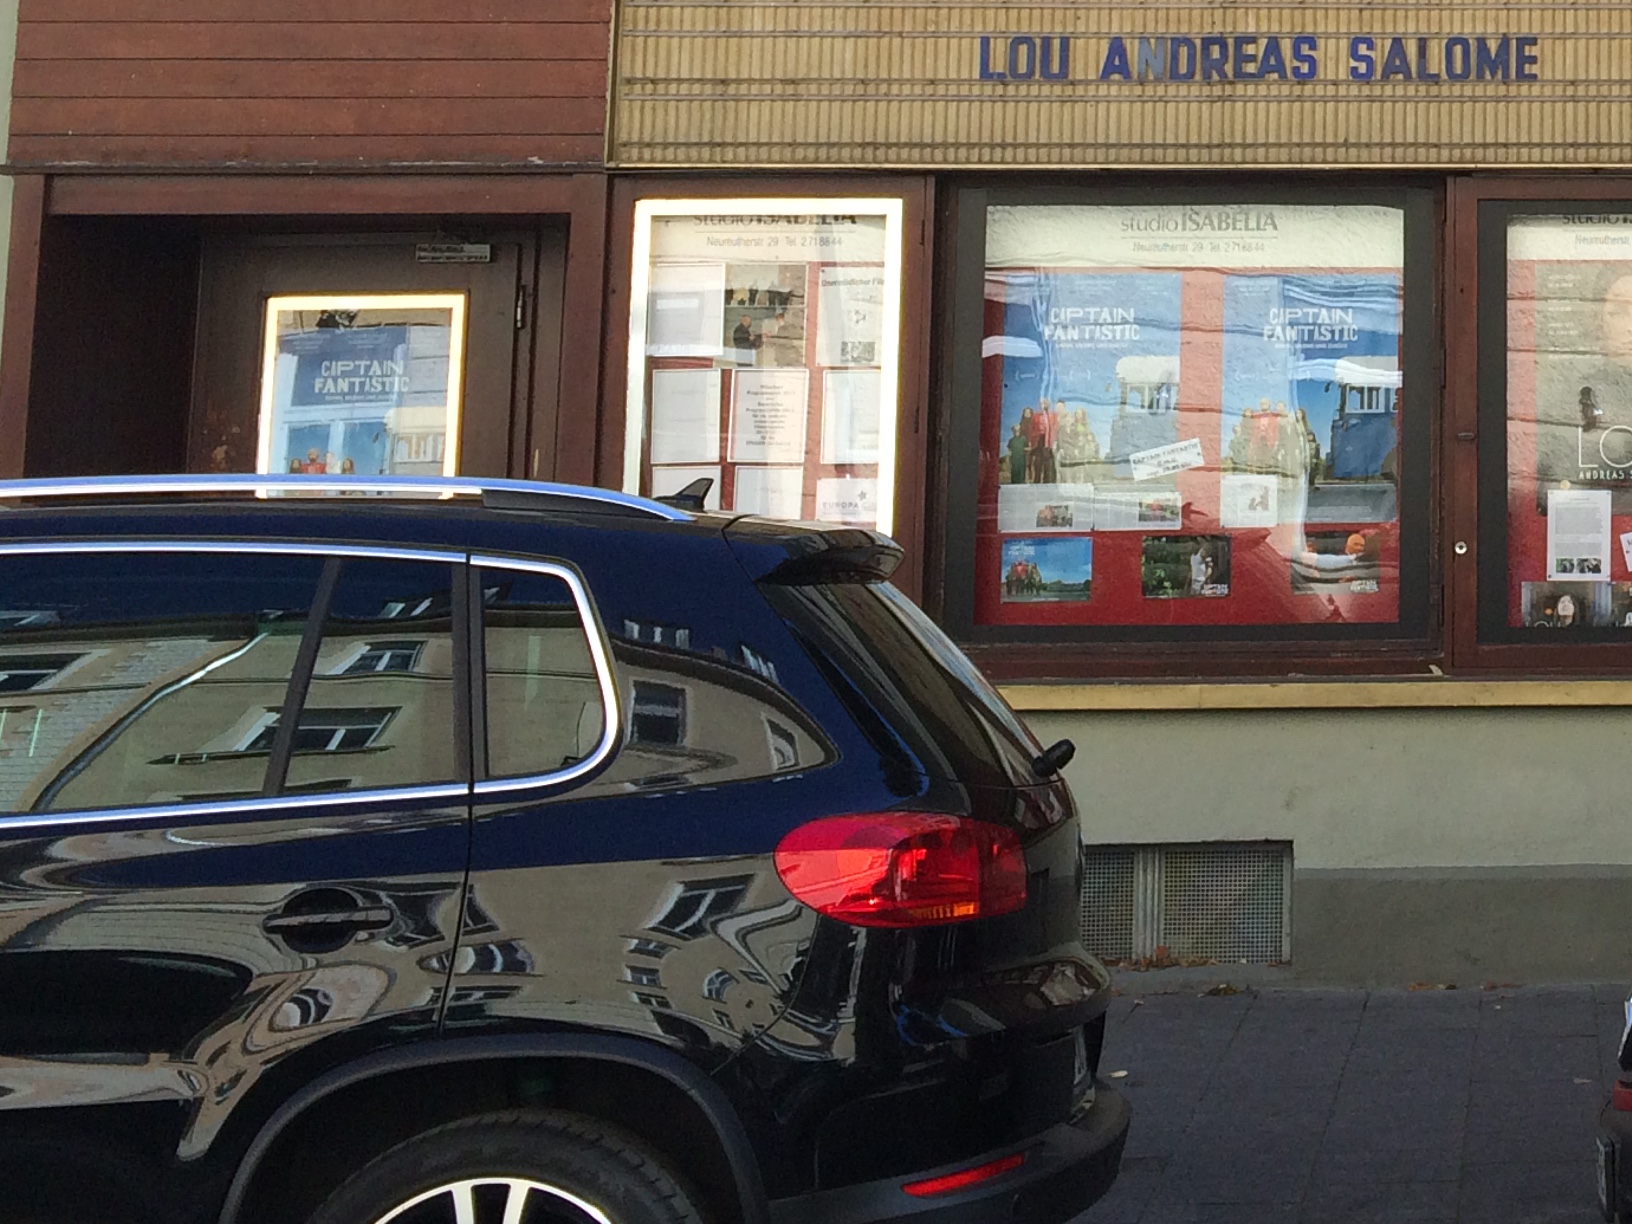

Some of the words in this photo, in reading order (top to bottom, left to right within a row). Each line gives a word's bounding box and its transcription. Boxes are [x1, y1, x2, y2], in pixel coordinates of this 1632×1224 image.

[979, 36, 1069, 80] LOU
[1101, 36, 1317, 80] ANDREAS
[1350, 36, 1538, 81] SALOME
[1579, 469, 1625, 481] ANDREAS
